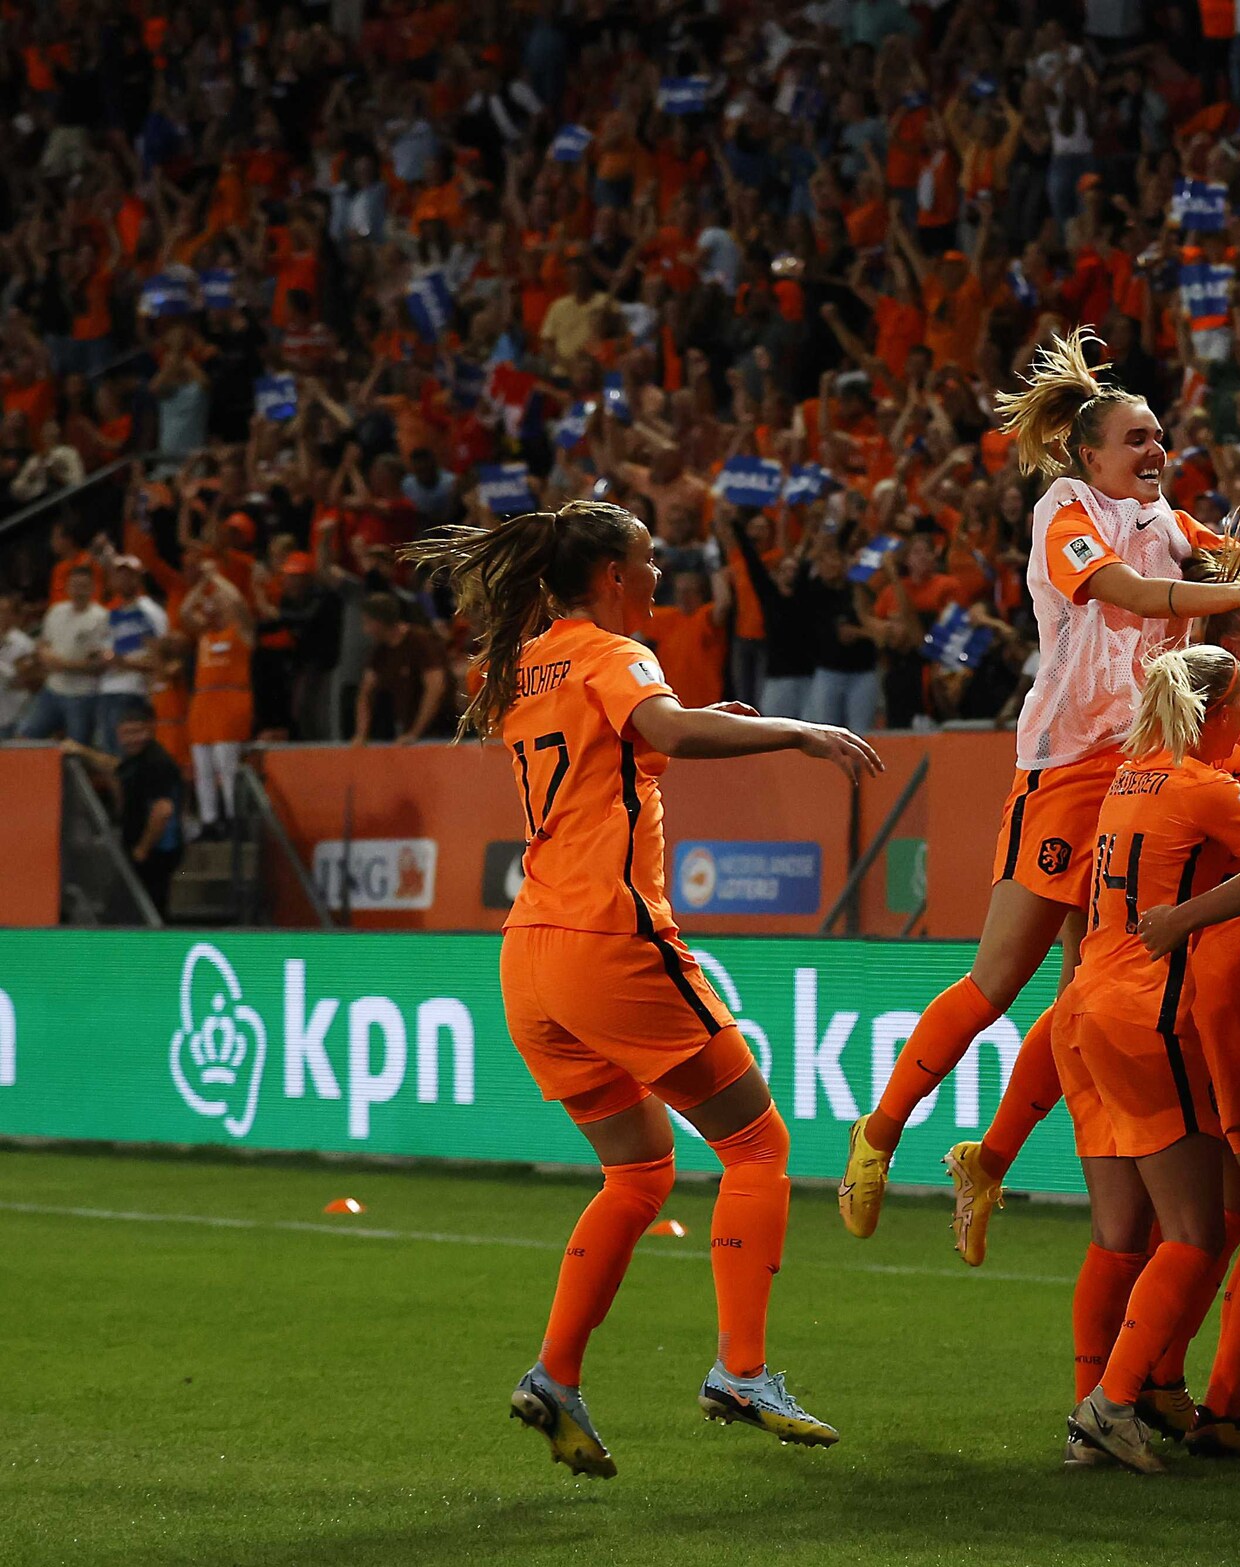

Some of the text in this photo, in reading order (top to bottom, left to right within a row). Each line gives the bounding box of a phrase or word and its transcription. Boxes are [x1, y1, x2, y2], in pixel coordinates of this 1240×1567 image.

[516, 659, 571, 698] EUCHTER
[512, 731, 570, 845] 17
[1093, 833, 1144, 934] 14
[284, 959, 474, 1139] kpn
